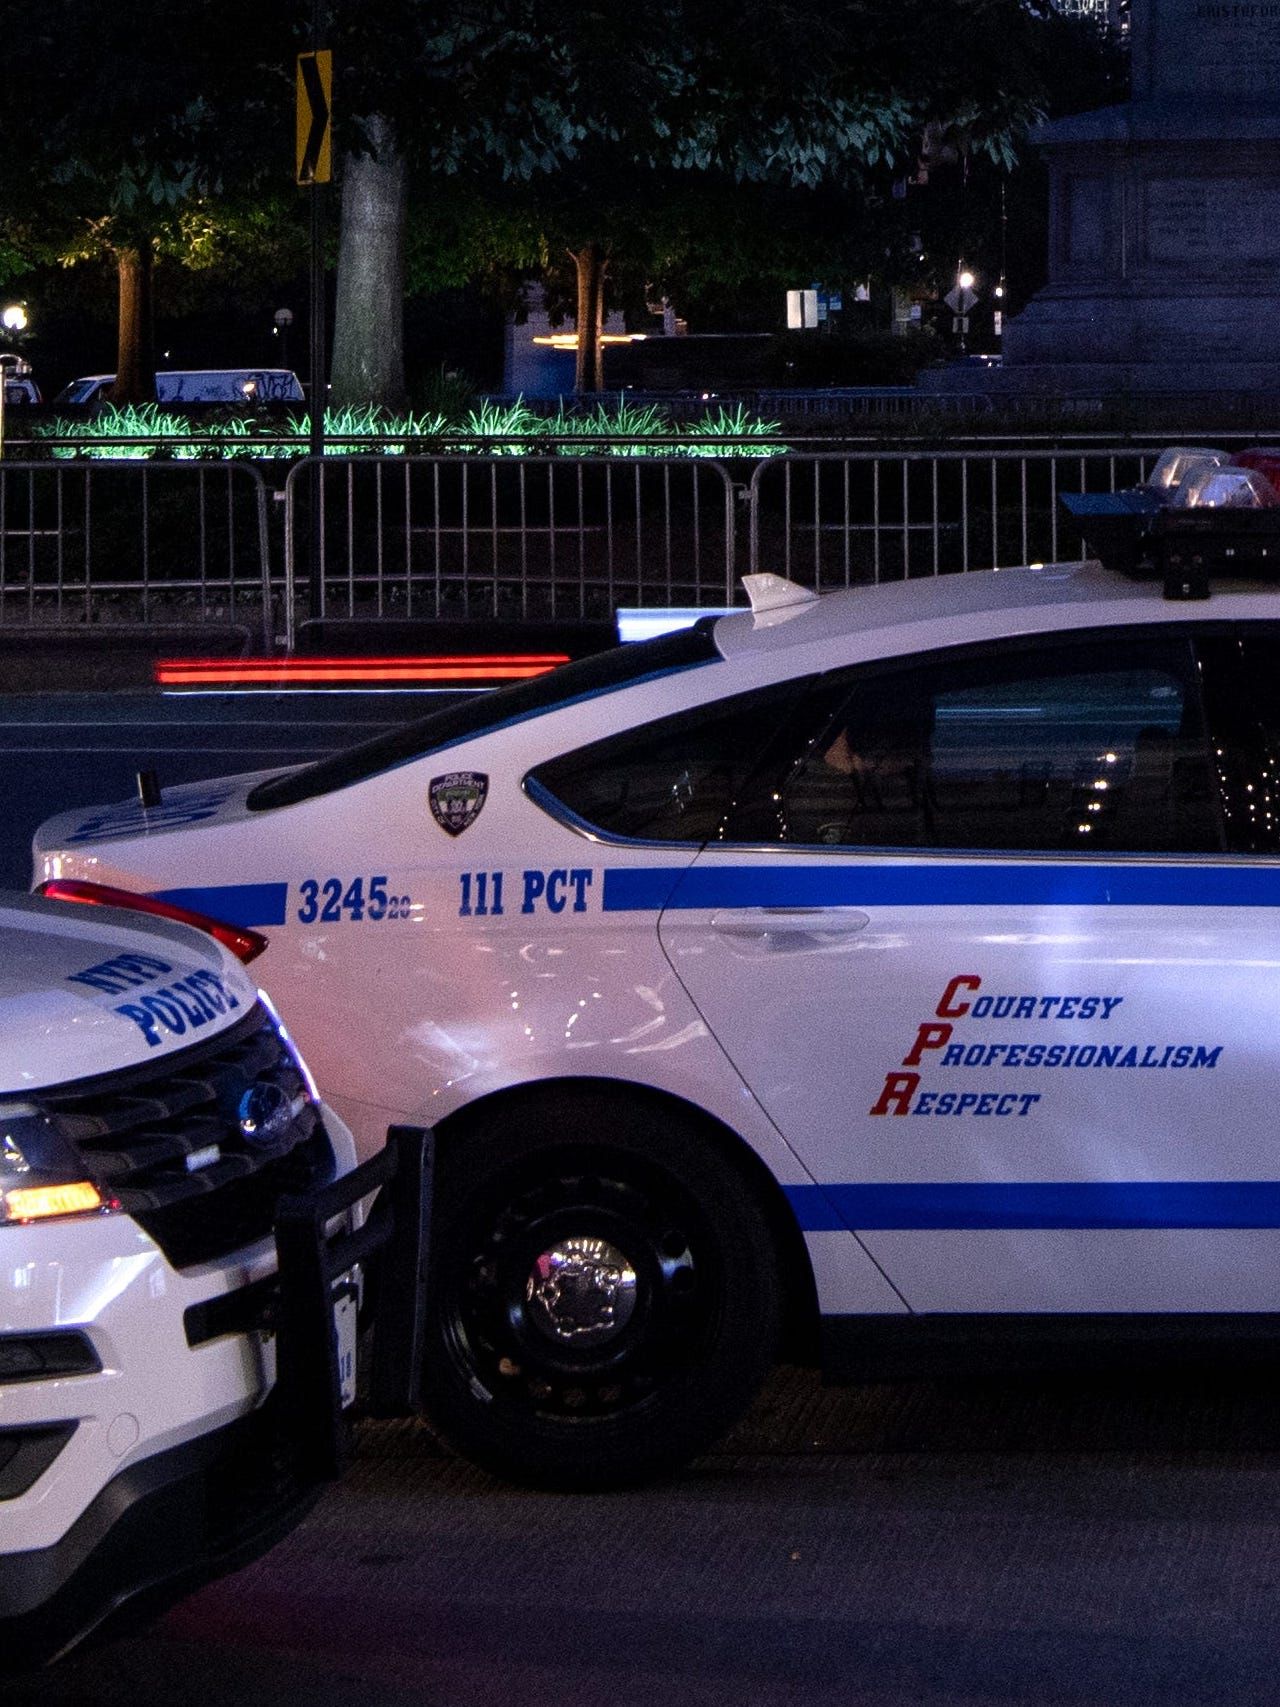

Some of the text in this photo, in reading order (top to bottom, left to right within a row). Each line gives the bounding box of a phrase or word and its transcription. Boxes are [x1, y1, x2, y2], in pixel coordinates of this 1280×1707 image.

[298, 876, 411, 923] 3245 20
[459, 869, 592, 916] 111 PCT
[67, 954, 172, 995] NYPD
[114, 969, 240, 1046] POLICE
